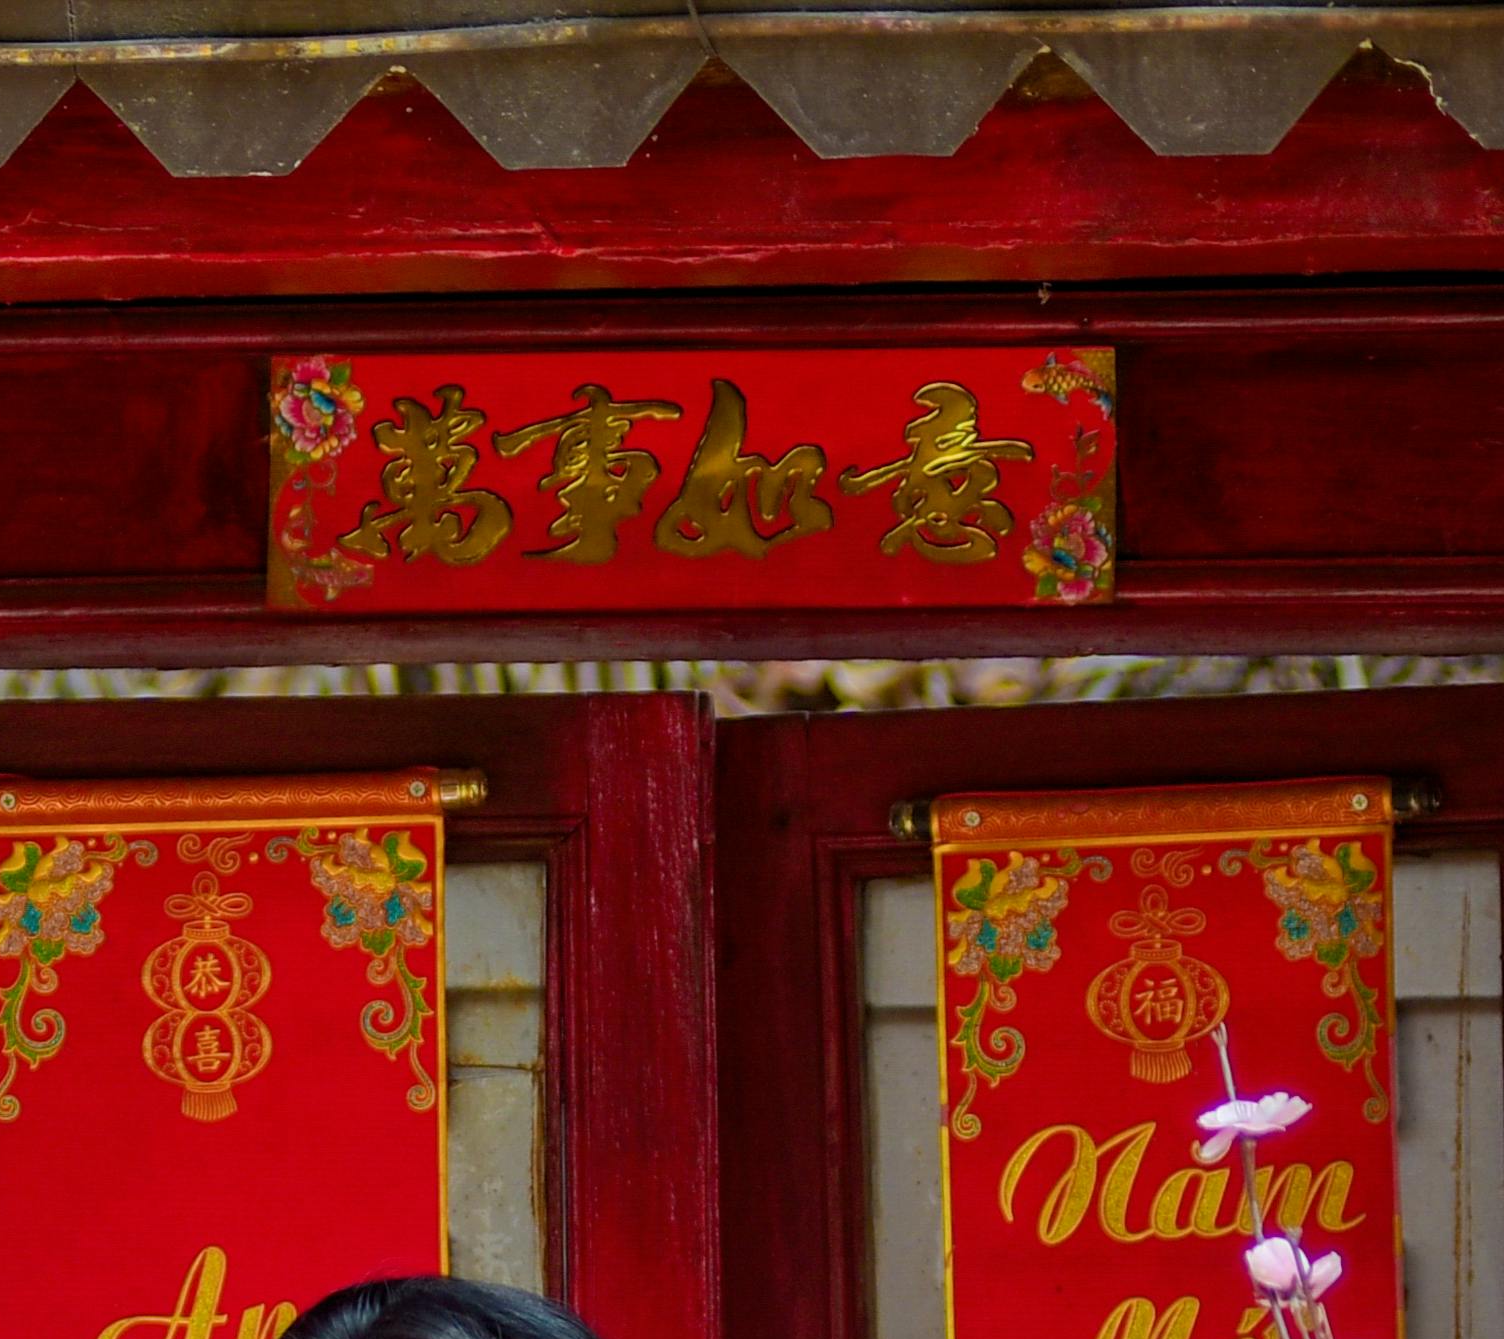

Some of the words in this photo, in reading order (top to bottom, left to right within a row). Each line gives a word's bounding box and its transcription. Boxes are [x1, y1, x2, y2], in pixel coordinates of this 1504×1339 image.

[337, 379, 1033, 566] 萬事如意
[1133, 977, 1184, 1025] 福
